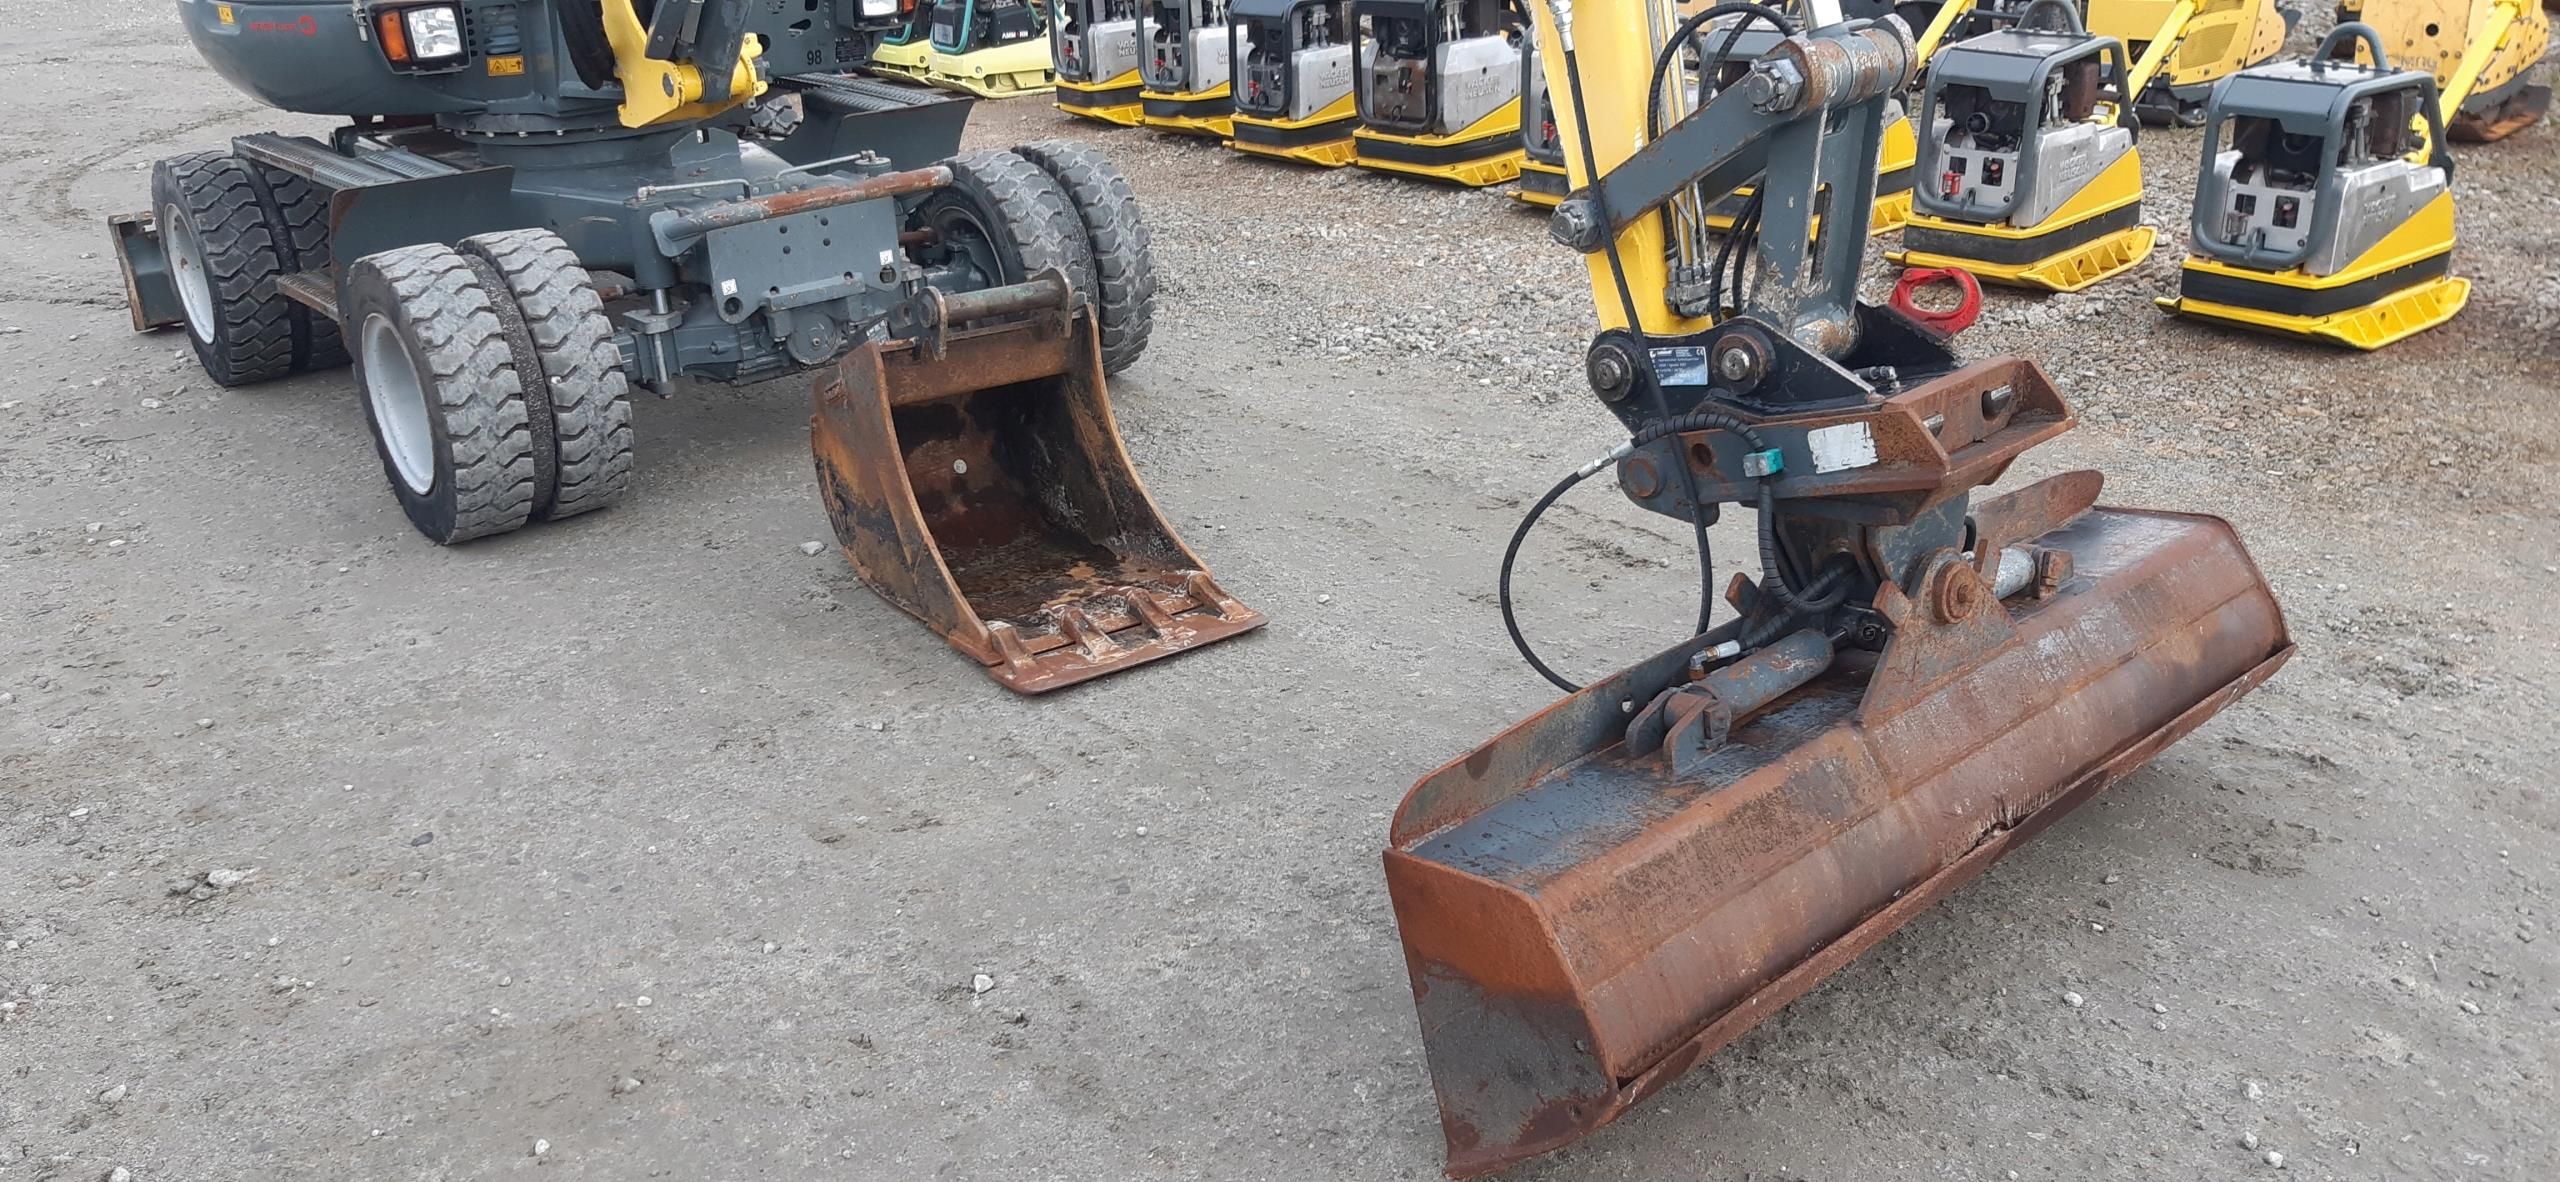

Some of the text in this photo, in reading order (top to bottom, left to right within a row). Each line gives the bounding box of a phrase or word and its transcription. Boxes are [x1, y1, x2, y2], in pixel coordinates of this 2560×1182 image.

[1117, 40, 1136, 49] WAC
[1118, 47, 1137, 57] NEU
[806, 50, 823, 66] 98
